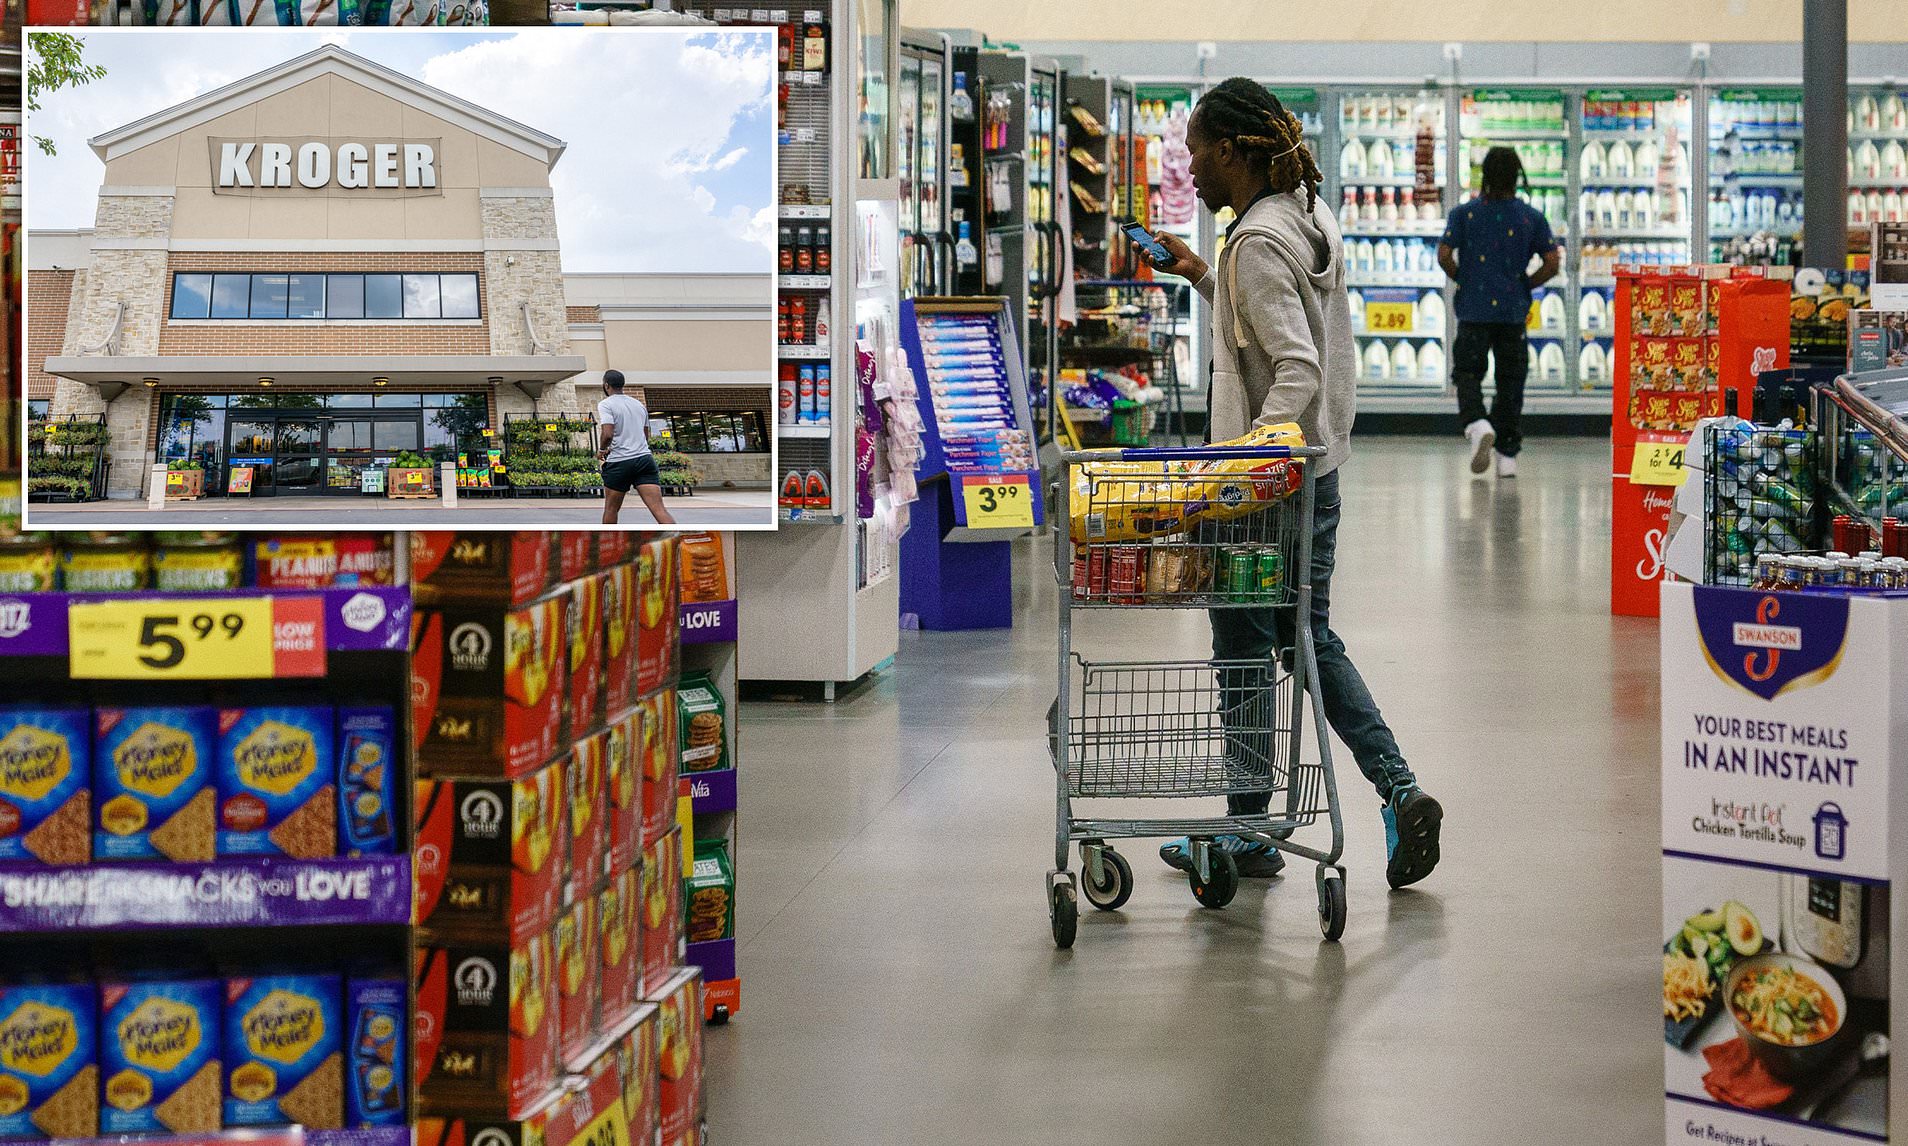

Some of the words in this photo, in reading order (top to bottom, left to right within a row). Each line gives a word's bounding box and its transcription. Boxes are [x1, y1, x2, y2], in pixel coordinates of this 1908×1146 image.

[219, 142, 436, 188] KROGER
[1650, 458, 1662, 468] for
[1654, 449, 1660, 458] 2
[269, 554, 337, 577] PEANUTS
[274, 622, 315, 640] LOW
[686, 611, 720, 629] LOVE
[274, 639, 314, 650] PRICE
[1737, 625, 1797, 645] SWANSON
[1694, 714, 1741, 739] YOUR
[1746, 719, 1786, 744] BEST
[1791, 726, 1848, 751] MEALS
[119, 742, 188, 767] Honey
[239, 741, 307, 766] Honey
[1684, 740, 1708, 769] IN
[1714, 745, 1747, 775] AN
[1754, 750, 1859, 788] INSTANT
[132, 761, 183, 782] Maid
[252, 759, 303, 782] Maid
[1712, 795, 1757, 823] Instant
[1692, 816, 1736, 838] Chicken
[1738, 823, 1777, 844] Tortilla
[1779, 828, 1807, 850] Soup
[4, 876, 99, 908] SHARE
[137, 872, 256, 903] SNACKS
[295, 870, 373, 901] LOVE
[124, 1016, 191, 1041] Honey
[250, 1007, 315, 1034] Honey
[12, 1037, 63, 1064] Maid
[135, 1033, 187, 1058] Maid
[259, 1027, 311, 1052] Maid
[1685, 1120, 1704, 1138] Get
